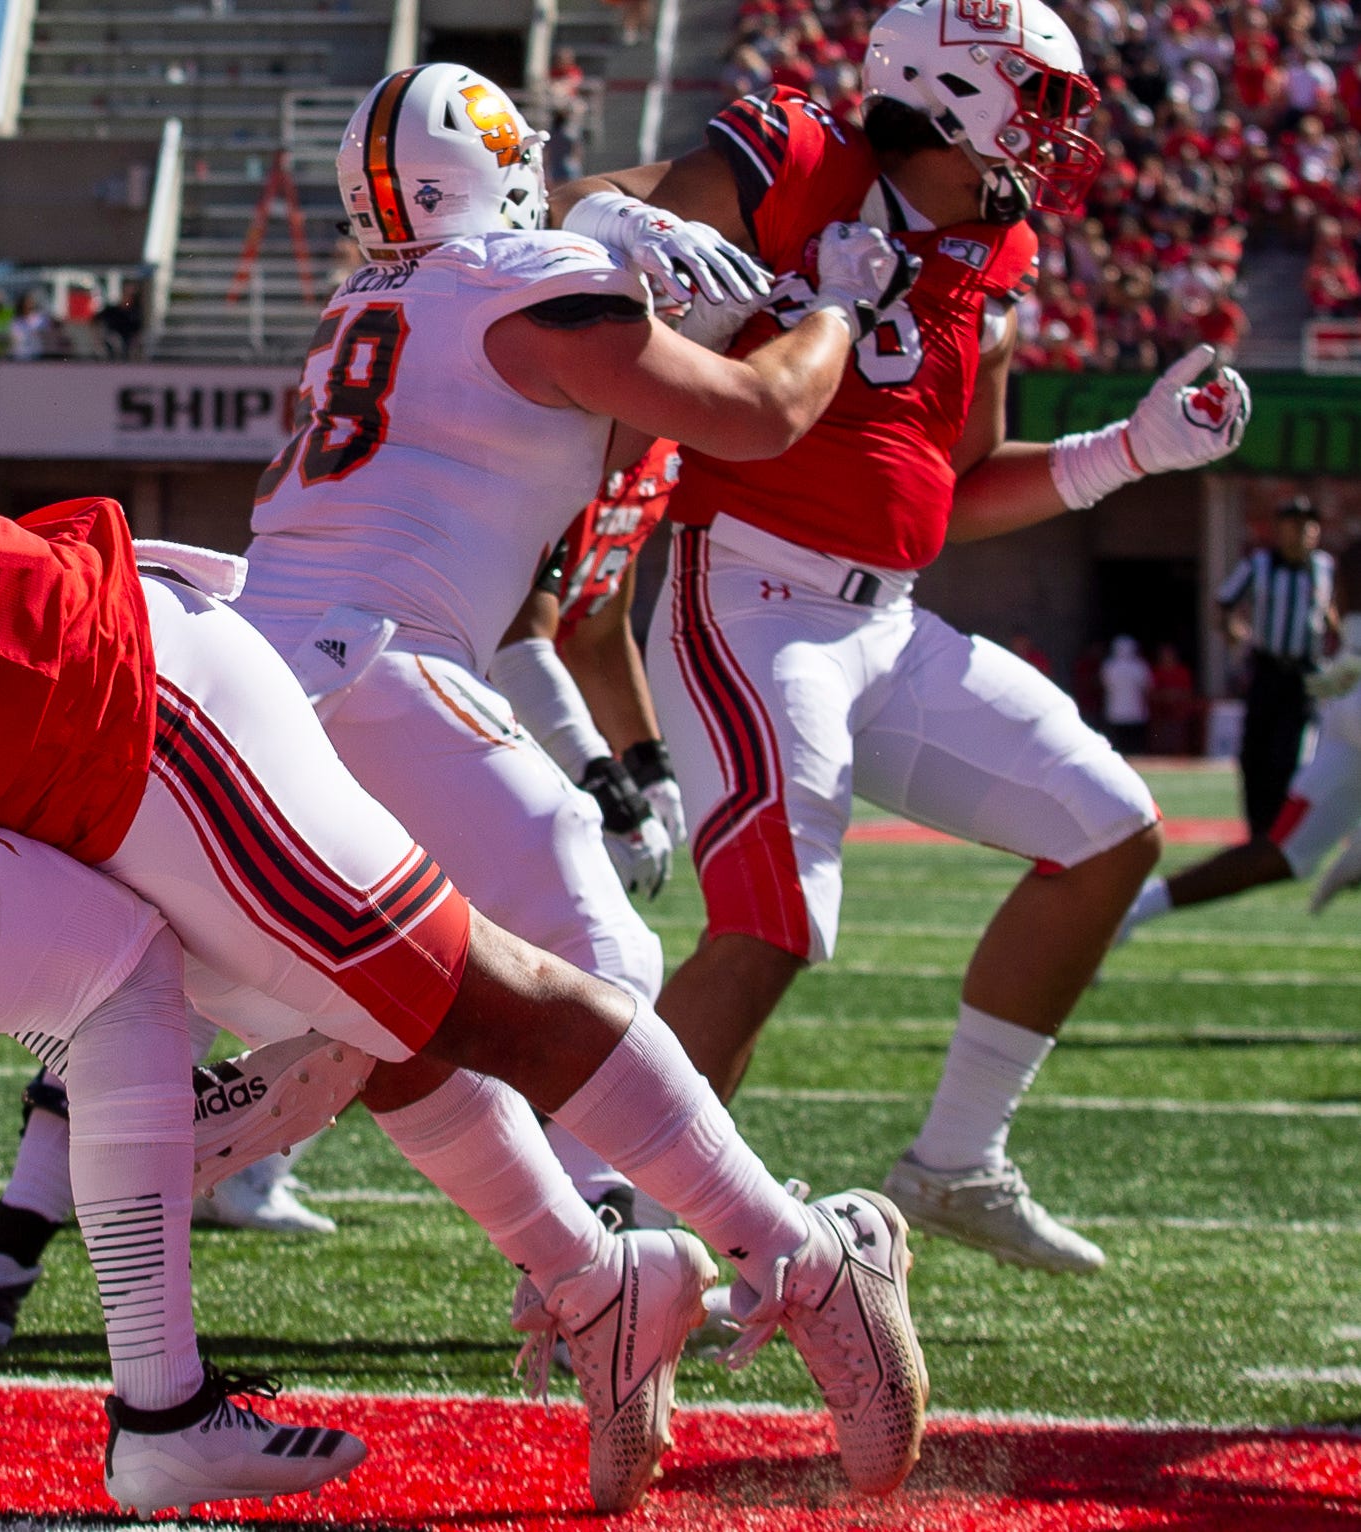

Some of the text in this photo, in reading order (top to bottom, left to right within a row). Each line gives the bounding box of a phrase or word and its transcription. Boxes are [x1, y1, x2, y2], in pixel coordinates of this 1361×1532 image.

[253, 302, 412, 506] 58
[624, 1266, 640, 1381] UNDER ARMOUR
